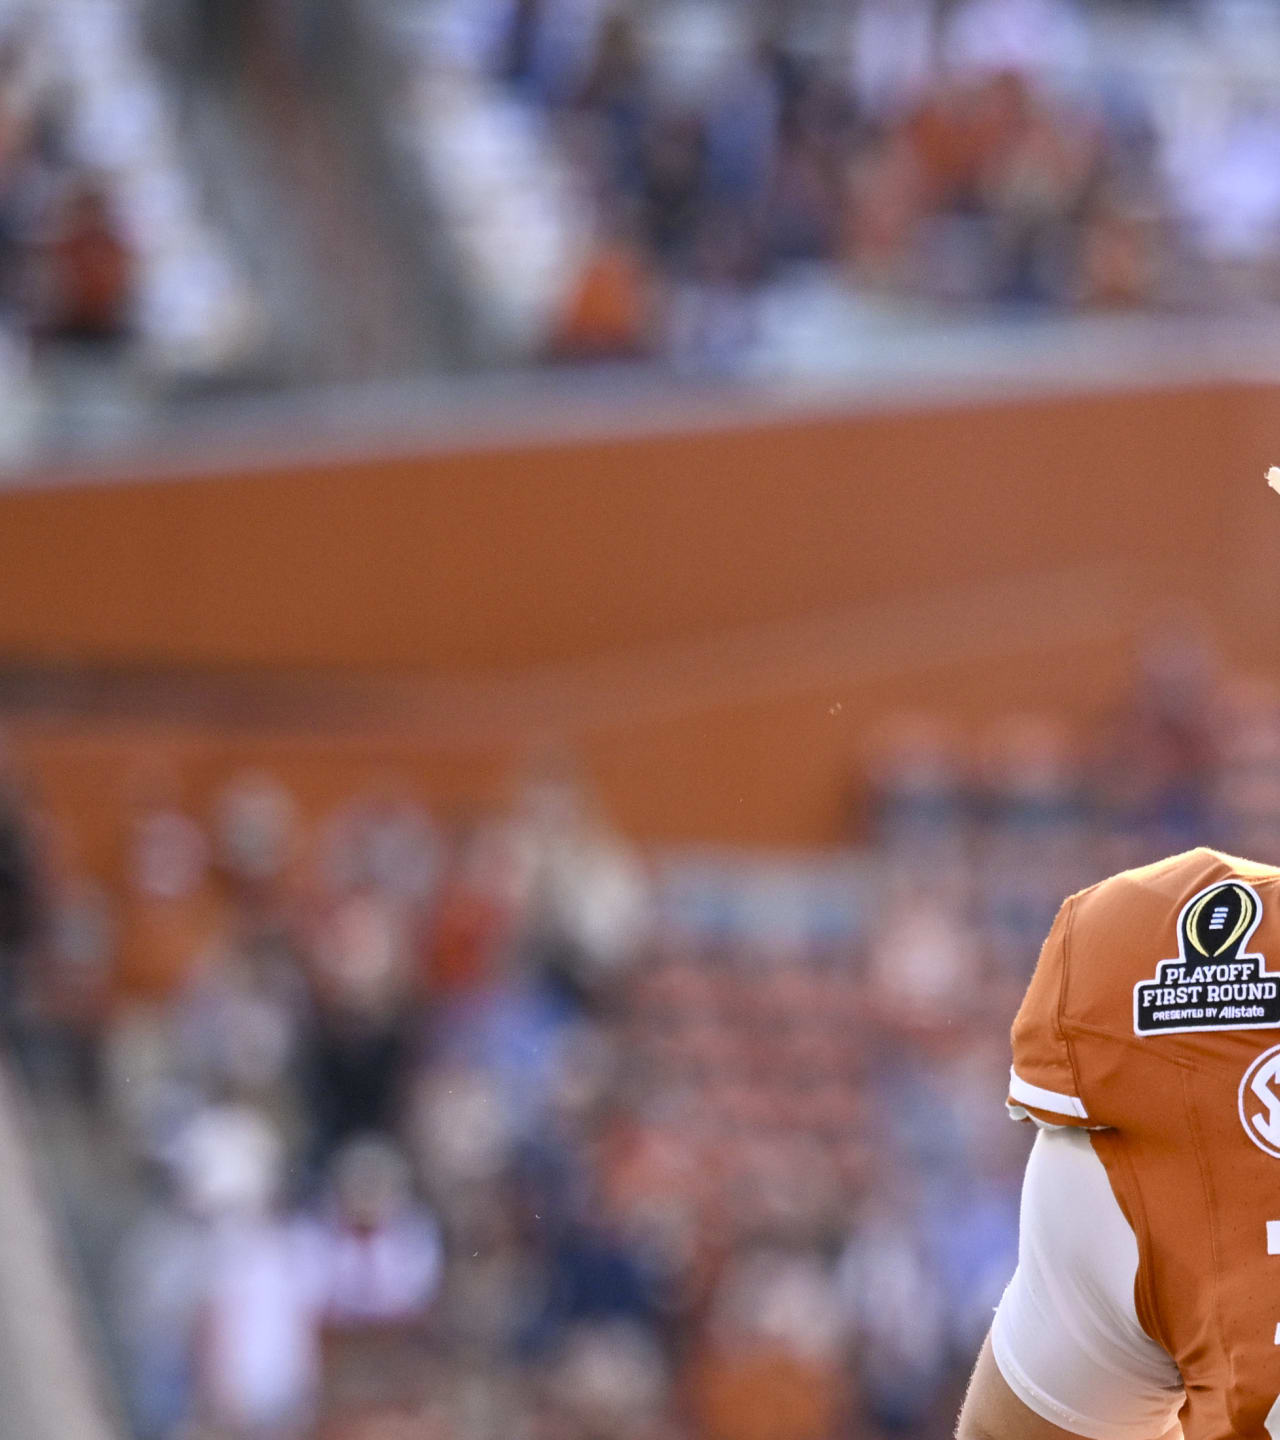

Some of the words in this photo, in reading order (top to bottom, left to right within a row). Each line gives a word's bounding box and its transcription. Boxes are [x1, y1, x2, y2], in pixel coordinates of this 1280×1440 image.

[1165, 964, 1255, 985] PLAYOFF
[1142, 986, 1203, 1007] FIRST
[1206, 982, 1277, 1002] ROUND
[1152, 1008, 1204, 1021] PRESENTED
[1205, 1008, 1218, 1018] BY
[1219, 1005, 1265, 1018] Allstate
